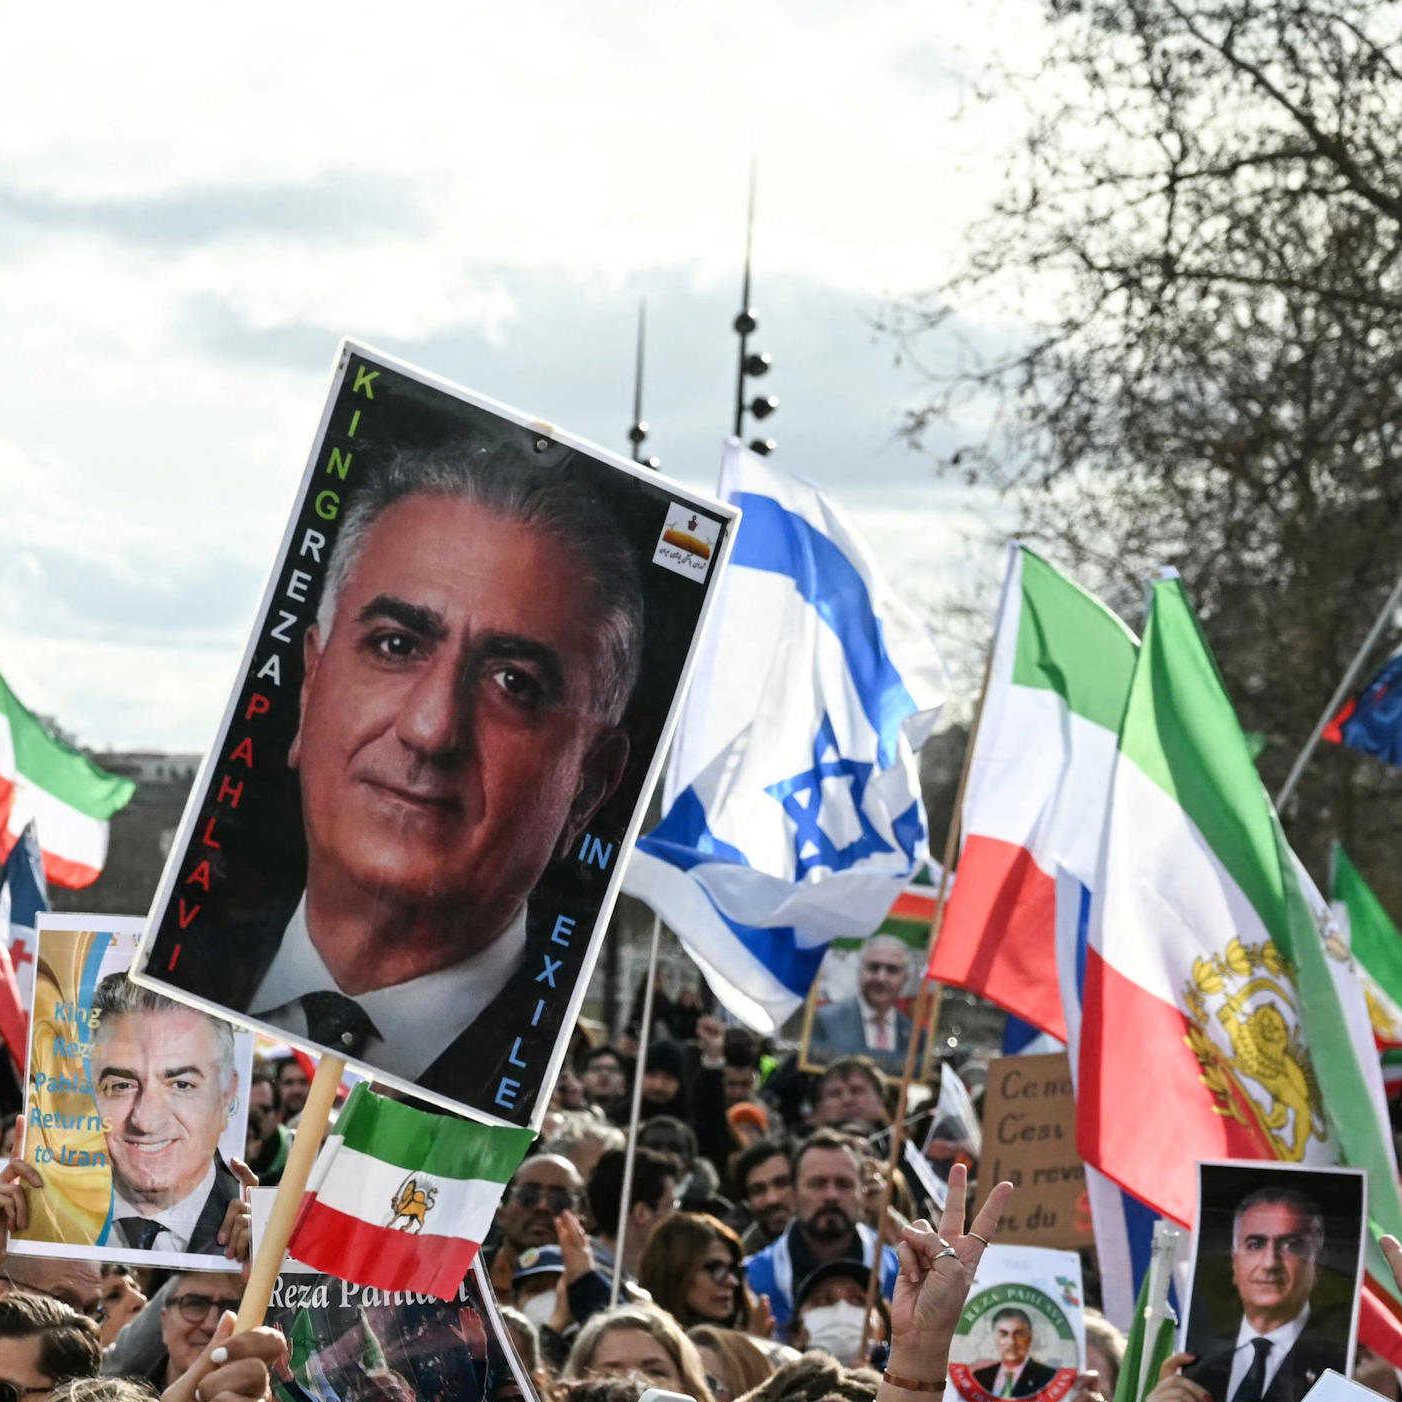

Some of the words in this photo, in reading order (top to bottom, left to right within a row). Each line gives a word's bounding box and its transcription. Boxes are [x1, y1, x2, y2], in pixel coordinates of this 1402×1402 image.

[312, 362, 380, 522] KING
[253, 526, 326, 688] REZA
[166, 692, 271, 974] PAHLAVI
[577, 831, 613, 871] IN
[54, 1001, 102, 1029] King
[491, 913, 576, 1110] EXILE
[30, 1107, 114, 1134] Returns
[35, 1144, 54, 1164] to
[59, 1144, 108, 1169] Iran
[267, 1275, 331, 1309] Reza
